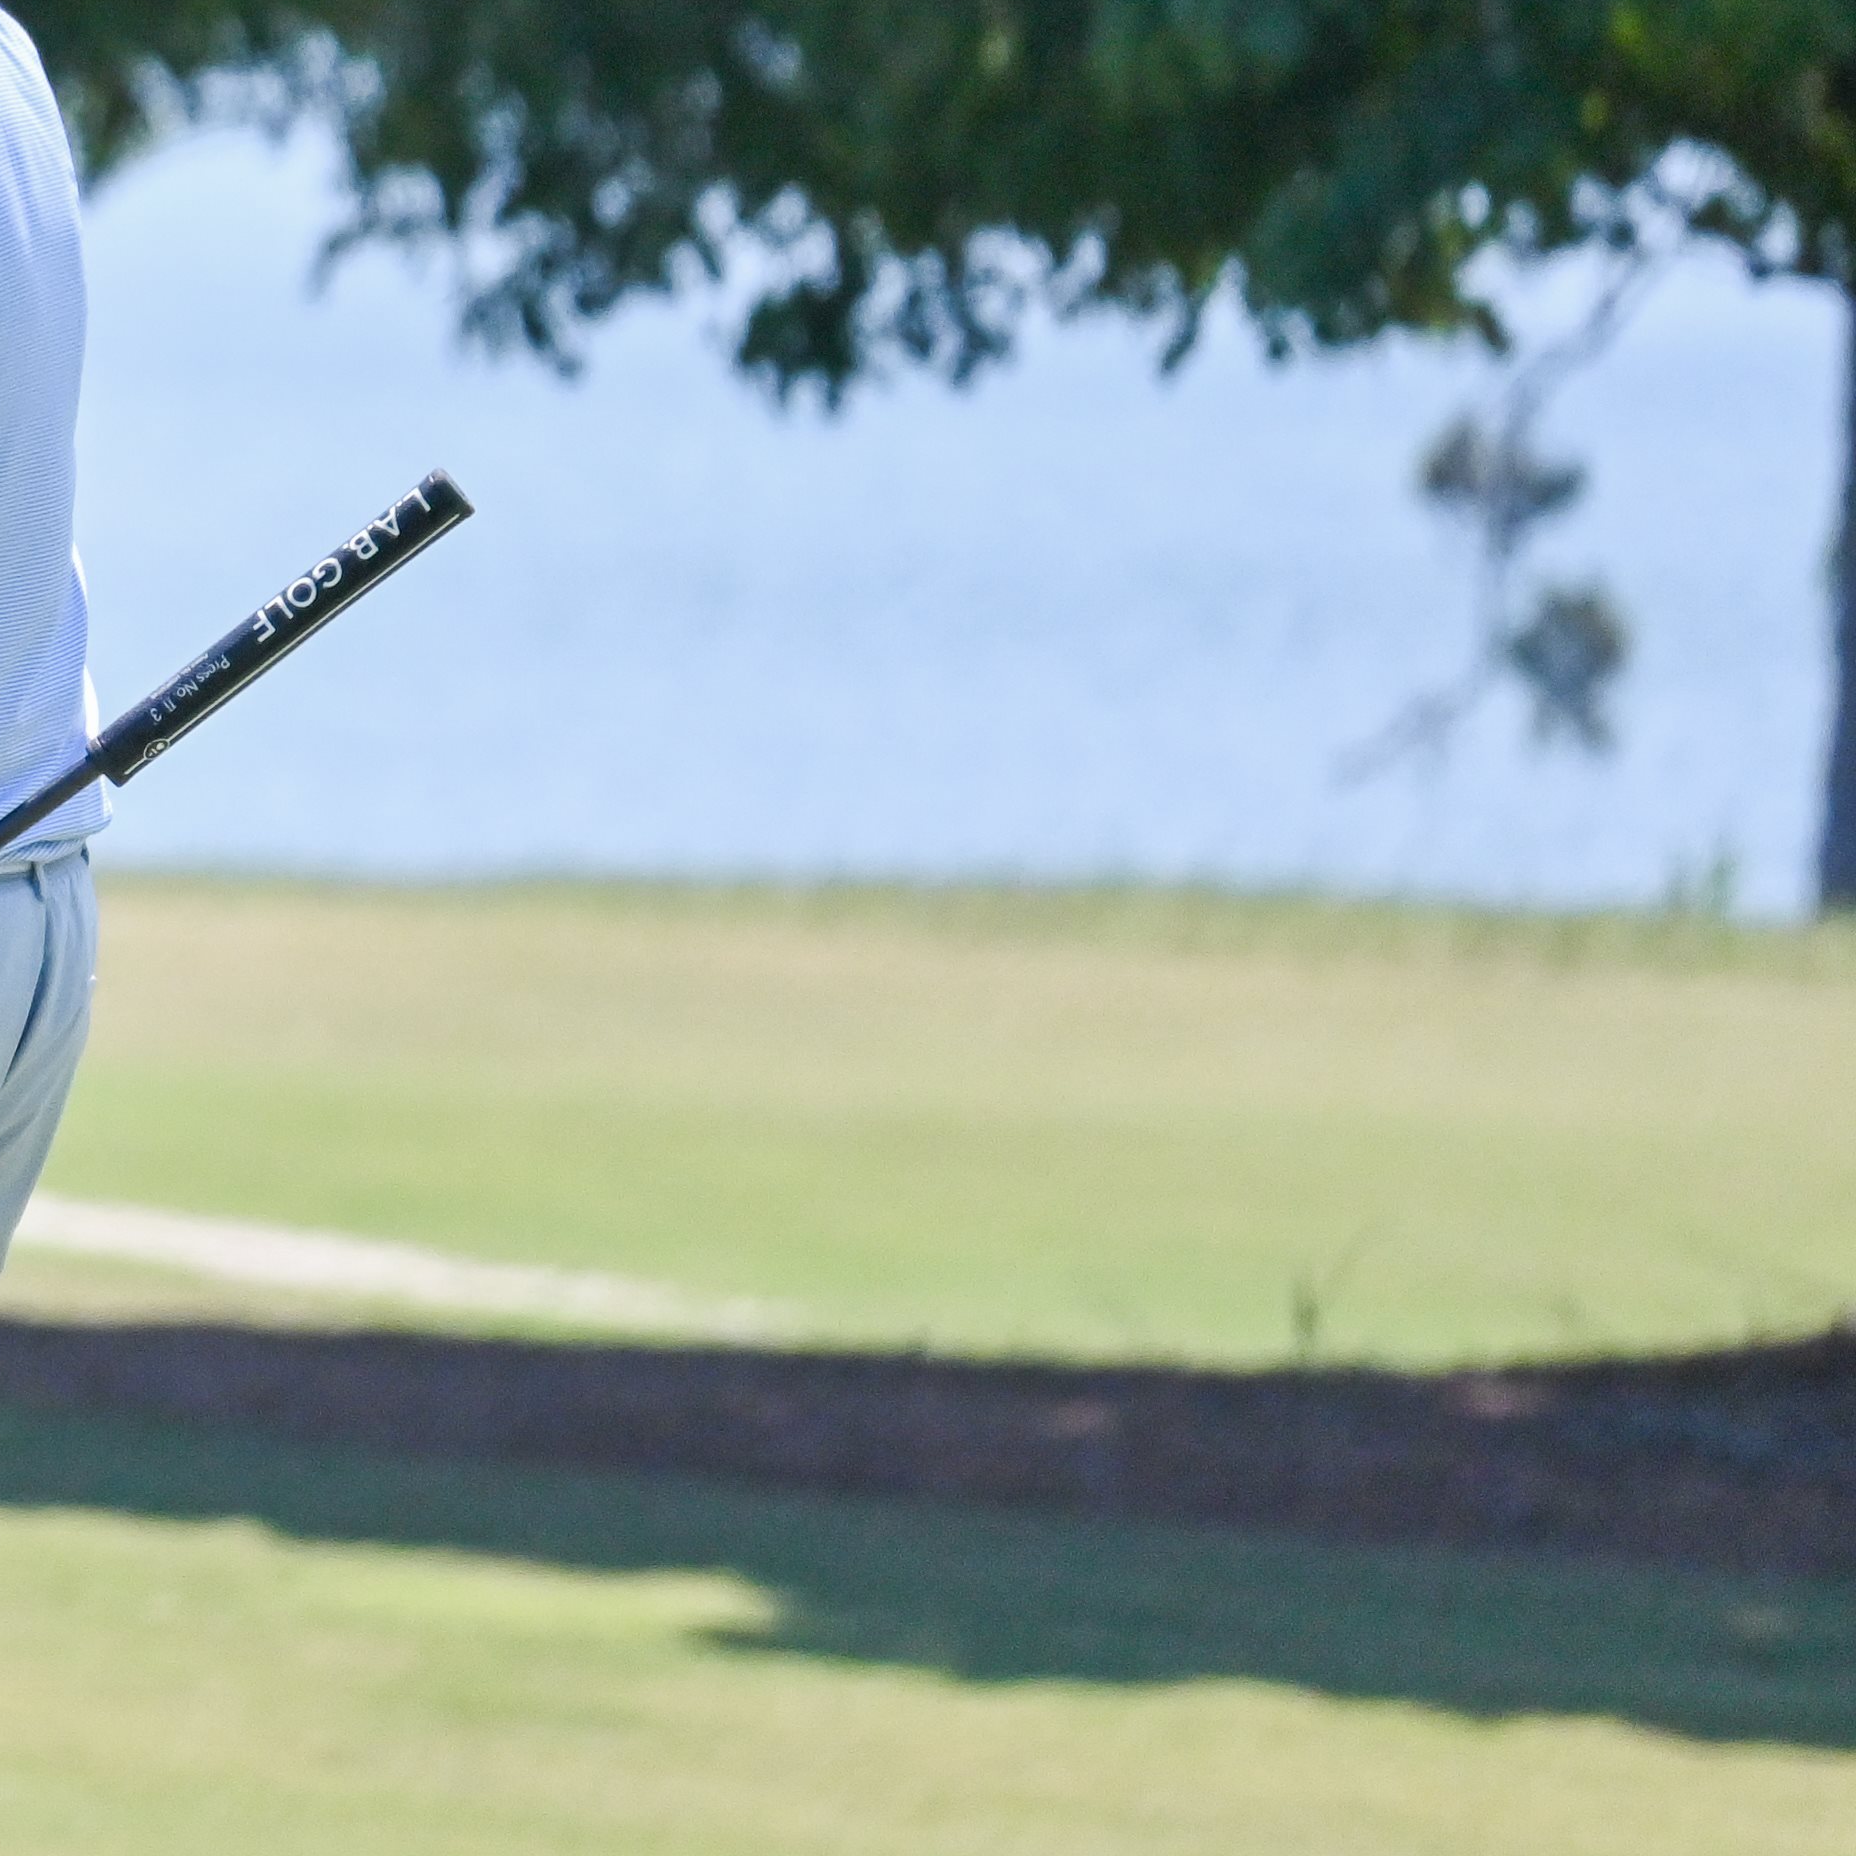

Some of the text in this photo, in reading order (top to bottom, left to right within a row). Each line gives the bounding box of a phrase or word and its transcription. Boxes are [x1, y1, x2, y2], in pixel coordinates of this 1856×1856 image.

[252, 487, 432, 643] L.A.B. GOLF
[195, 654, 231, 683] Press
